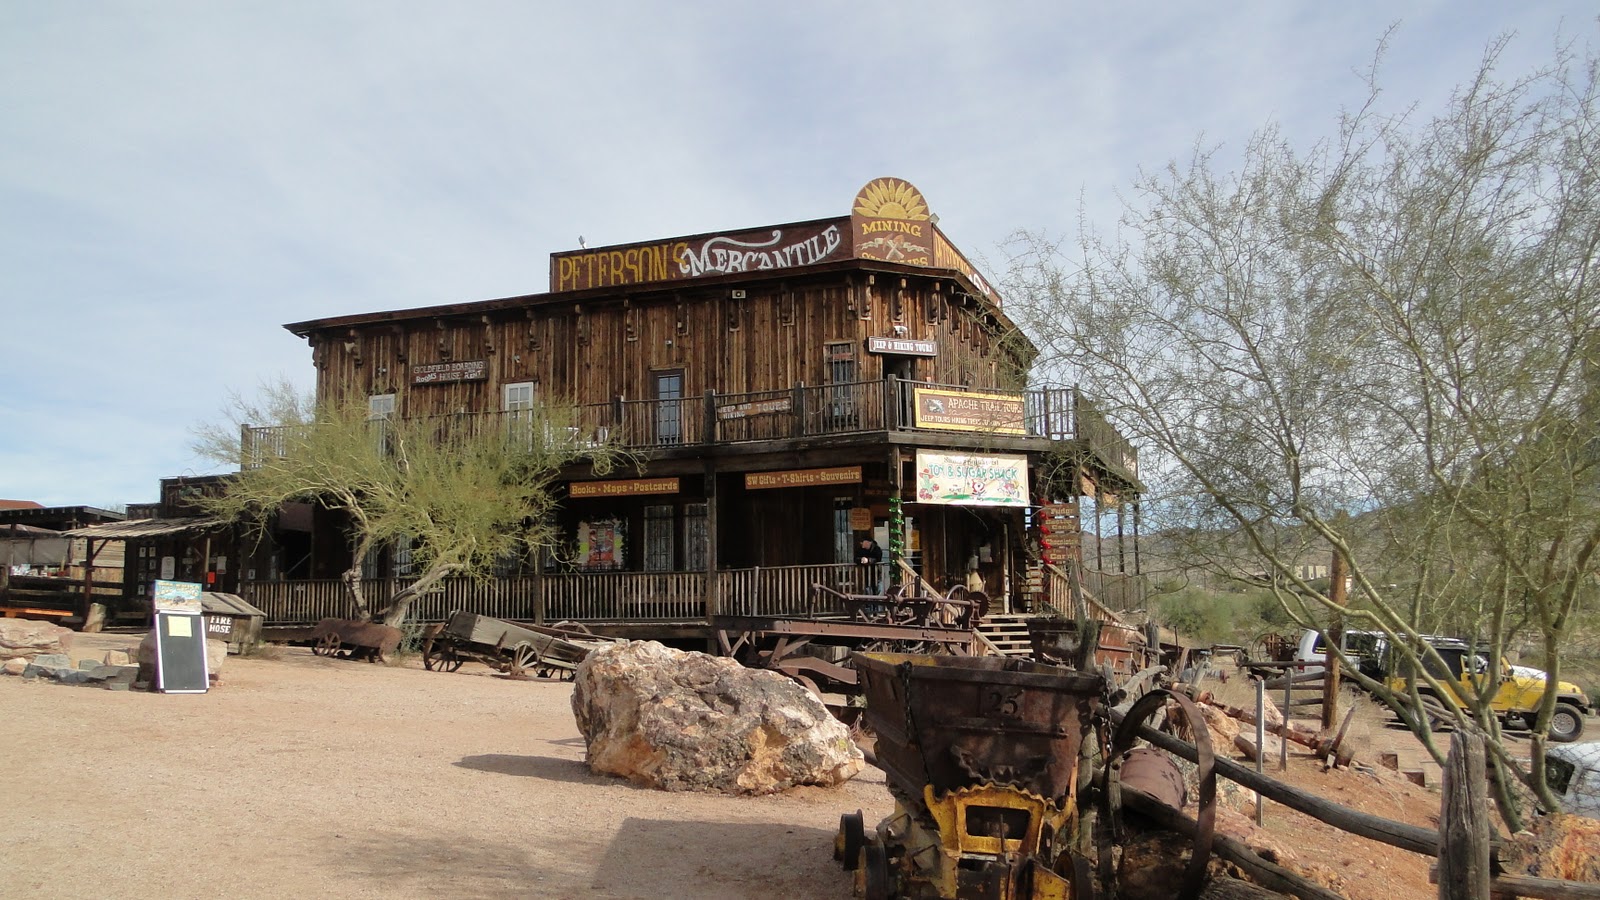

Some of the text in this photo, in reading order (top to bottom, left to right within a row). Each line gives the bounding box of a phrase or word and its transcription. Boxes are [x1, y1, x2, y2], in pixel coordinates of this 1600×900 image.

[862, 220, 922, 237] MINING
[679, 225, 841, 276] MERCANTILE
[413, 364, 450, 374] GOLDFIELD
[948, 398, 978, 410] APACHE
[935, 415, 950, 423] TOURS
[746, 470, 860, 485] SW Gifts T-Shirts Souvenirs
[947, 466, 954, 477] &
[957, 466, 987, 479] SUGAR
[989, 468, 1017, 480] SHACK
[571, 482, 678, 494] Books Maps Postcards
[210, 615, 232, 625] FIRE
[209, 624, 231, 634] HOSE
[989, 690, 1019, 715] 25
